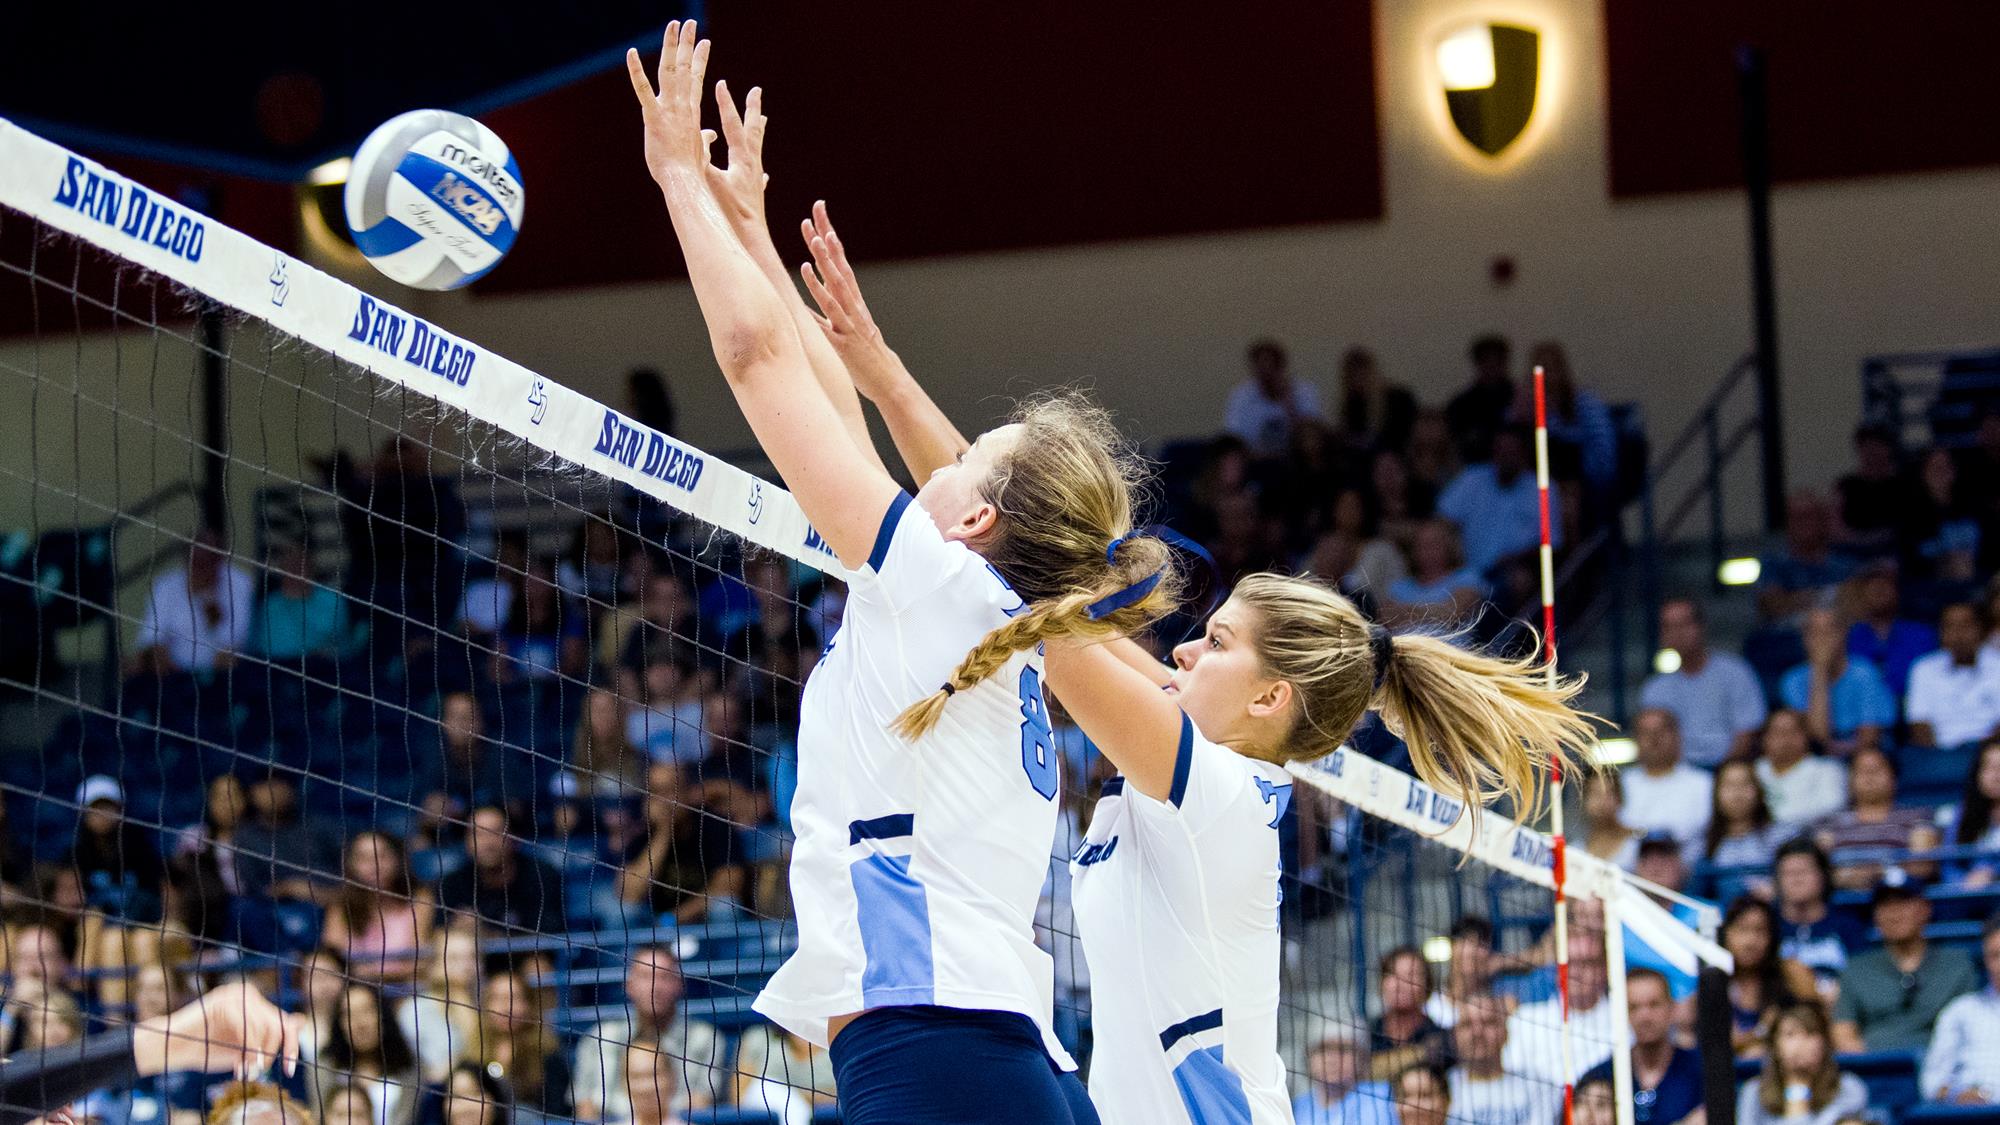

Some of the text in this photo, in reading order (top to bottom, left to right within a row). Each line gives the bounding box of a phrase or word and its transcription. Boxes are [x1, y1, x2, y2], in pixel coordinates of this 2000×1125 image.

[53, 155, 205, 263] SAN DIEGO
[432, 172, 506, 235] NCAA
[441, 143, 517, 208] molten
[348, 294, 476, 387] SAN DIEGO
[593, 409, 704, 493] SAN DIEGO
[1019, 664, 1058, 802] 8
